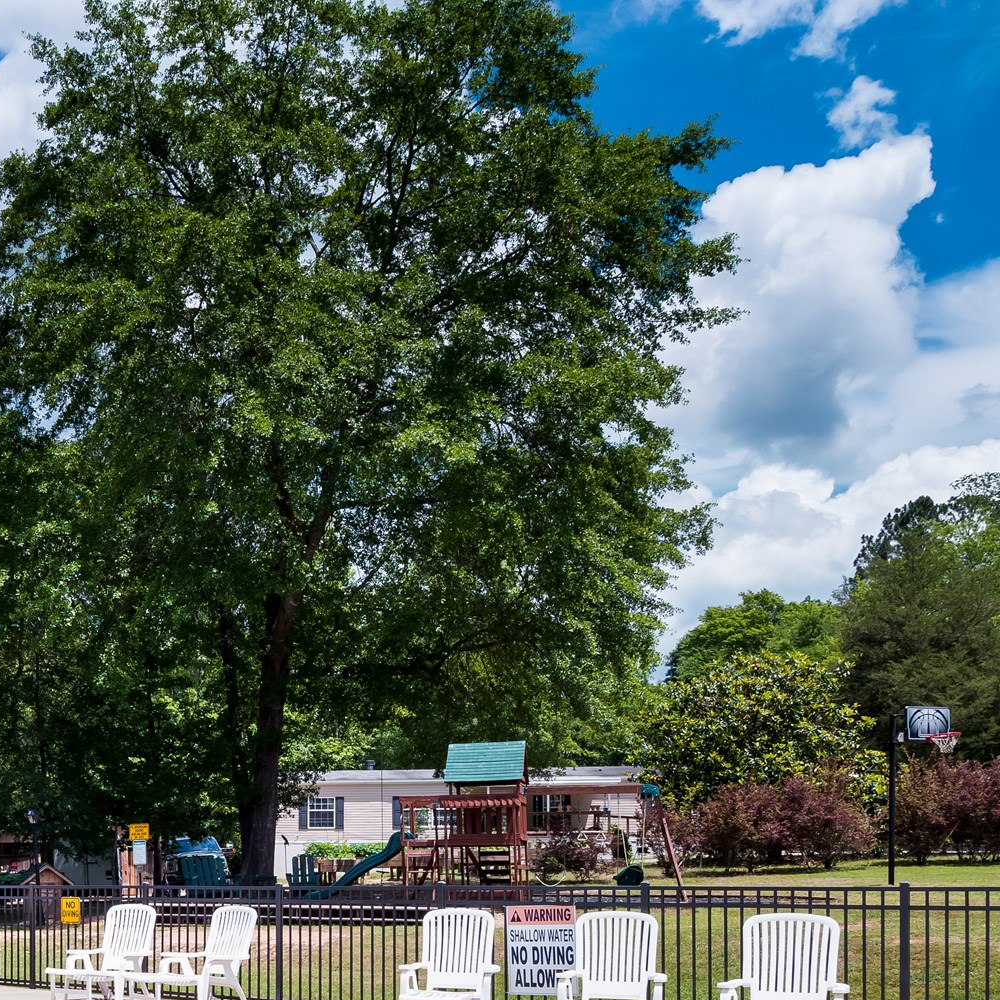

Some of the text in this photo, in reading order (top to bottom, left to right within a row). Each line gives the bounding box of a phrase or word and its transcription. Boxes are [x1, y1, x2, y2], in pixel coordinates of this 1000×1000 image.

[65, 901, 76, 909] NO
[524, 908, 571, 922] WARNING
[510, 928, 574, 942] SHALLOW WATER
[511, 946, 574, 965] NO DIVING
[515, 969, 570, 988] ALLOW
